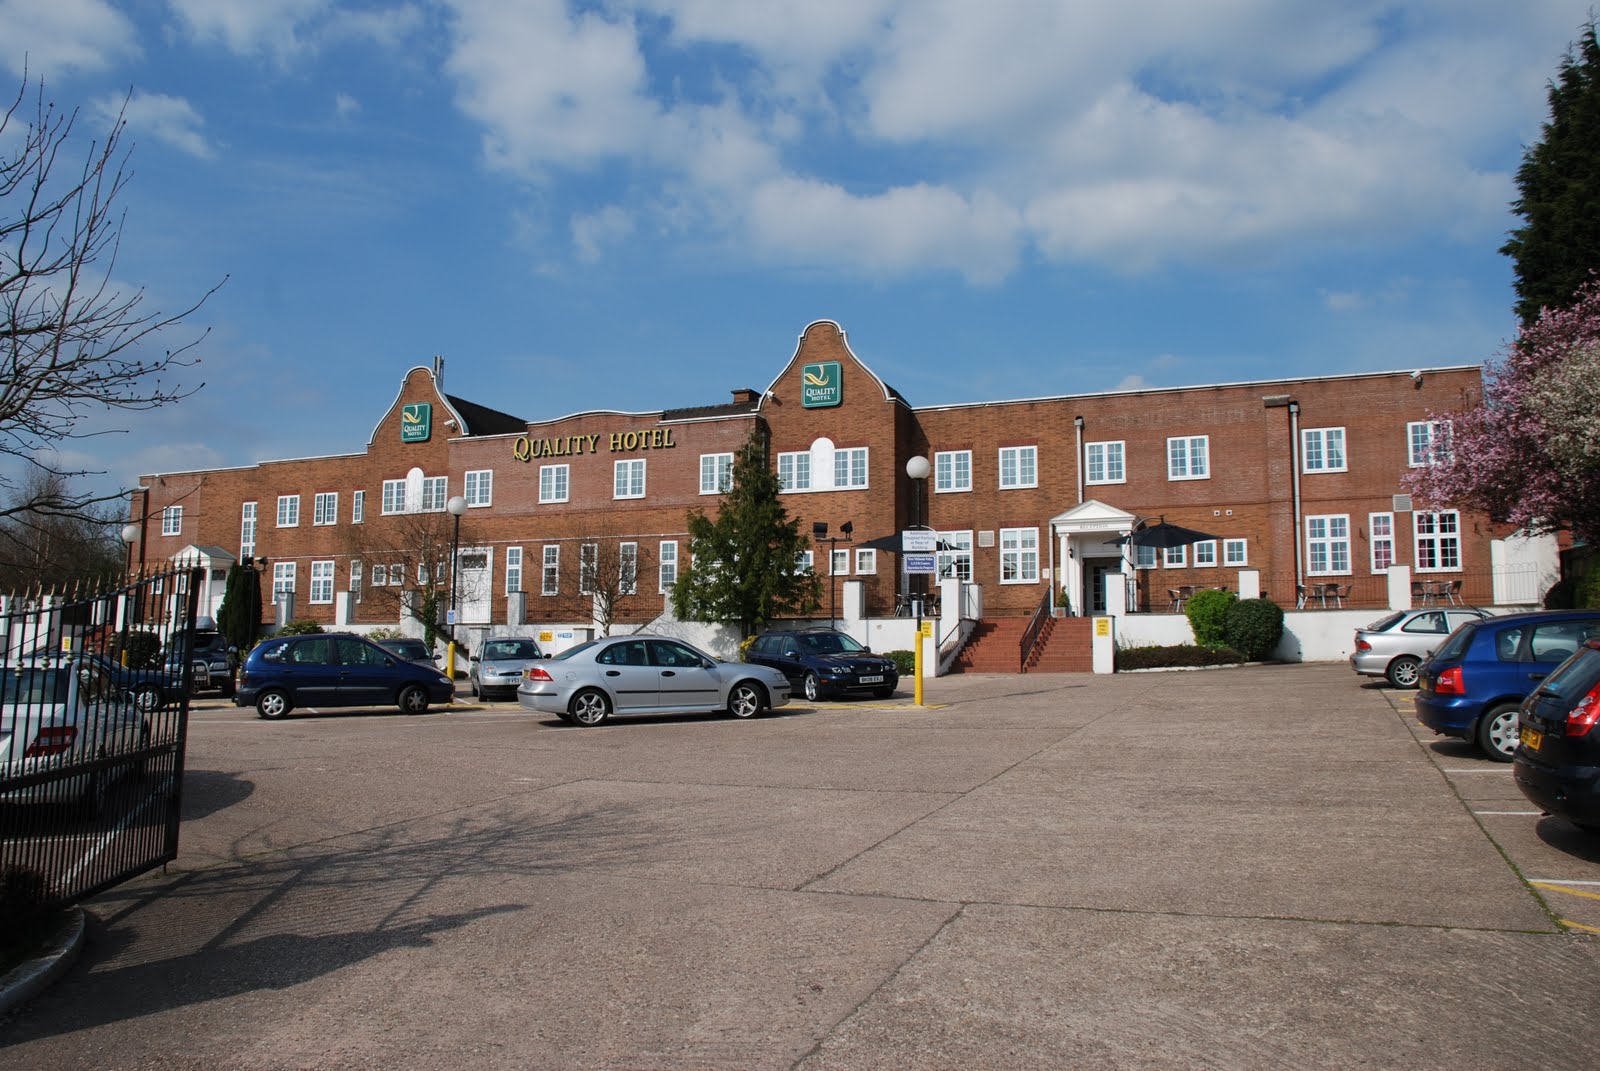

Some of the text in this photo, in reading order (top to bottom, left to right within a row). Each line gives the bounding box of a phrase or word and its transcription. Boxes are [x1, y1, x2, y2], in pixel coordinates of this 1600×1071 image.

[806, 387, 836, 397] QUALITY
[404, 424, 426, 432] QUALITY
[513, 428, 676, 462] QUALITY HOTEL
